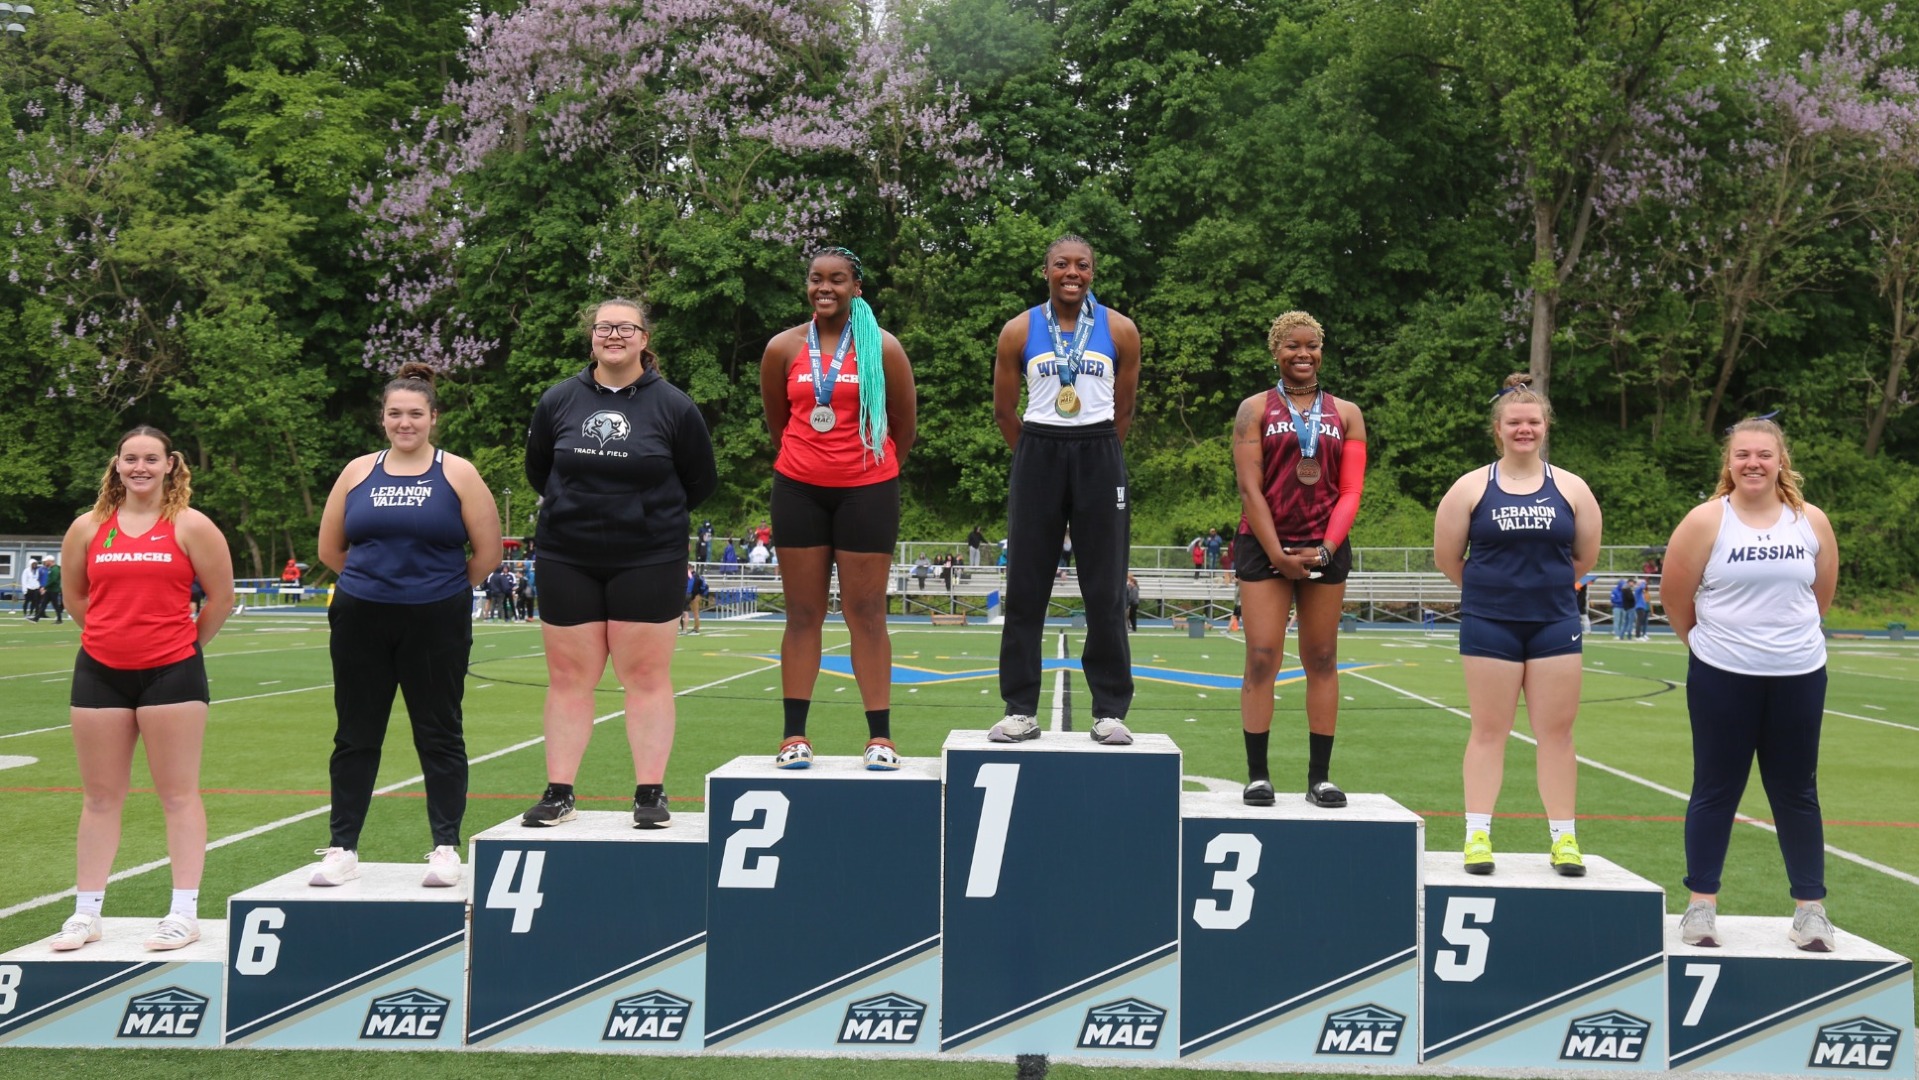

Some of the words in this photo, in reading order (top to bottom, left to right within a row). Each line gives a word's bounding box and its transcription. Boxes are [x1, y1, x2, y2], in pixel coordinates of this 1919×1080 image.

[606, 450, 629, 458] FIELD
[370, 486, 432, 498] LEBANON
[373, 496, 426, 507] VALLEY
[1491, 505, 1556, 521] LEBANON
[1497, 517, 1552, 531] VALLEY
[95, 552, 173, 563] MONARCHS
[1726, 545, 1805, 564] MESSIAH
[717, 790, 790, 889] 2
[965, 762, 1021, 898] 1
[485, 850, 546, 933] 4
[1192, 832, 1263, 930] 3
[235, 907, 286, 976] 6
[1433, 896, 1496, 982] 5
[0, 964, 23, 1015] 8
[1682, 963, 1721, 1026] 7
[123, 1013, 199, 1035] MAC
[366, 1015, 441, 1036] MAC
[608, 1016, 683, 1038] MAC
[843, 1019, 917, 1040] MAC
[1083, 1024, 1157, 1046] MAC
[1321, 1030, 1397, 1052] MAC
[1565, 1035, 1642, 1059] MAC
[1814, 1043, 1892, 1066] MAC
